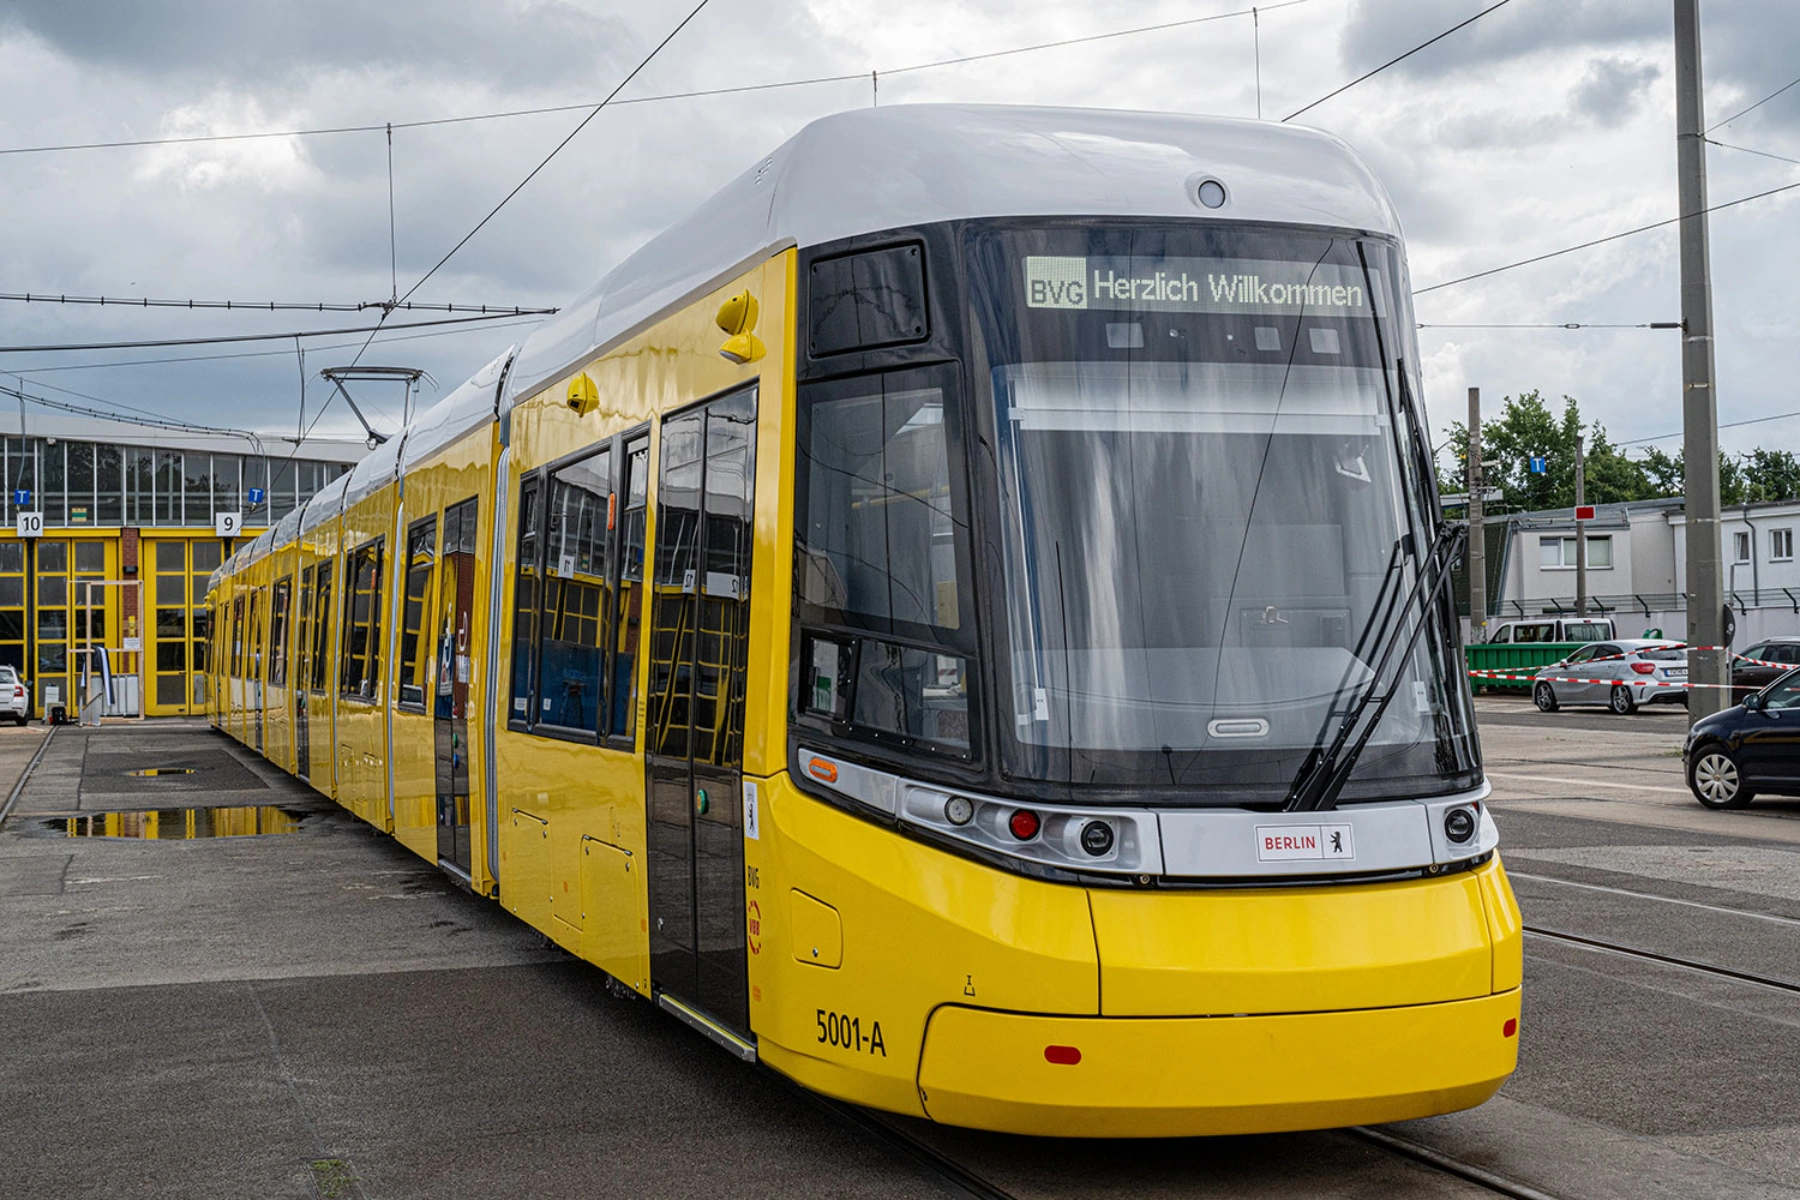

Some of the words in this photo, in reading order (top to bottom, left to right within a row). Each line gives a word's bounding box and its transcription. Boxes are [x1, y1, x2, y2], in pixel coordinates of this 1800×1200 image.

[1031, 279, 1084, 305] BVG
[1094, 270, 1198, 302] Herzlich
[1209, 274, 1363, 307] Willkommen
[1533, 457, 1542, 471] T
[17, 490, 27, 504] T
[252, 488, 261, 501] T
[22, 516, 40, 531] 10
[223, 516, 233, 531] 9
[1264, 835, 1317, 851] BERLIN
[748, 865, 760, 889] BVG
[816, 1009, 887, 1057] 5001-A
